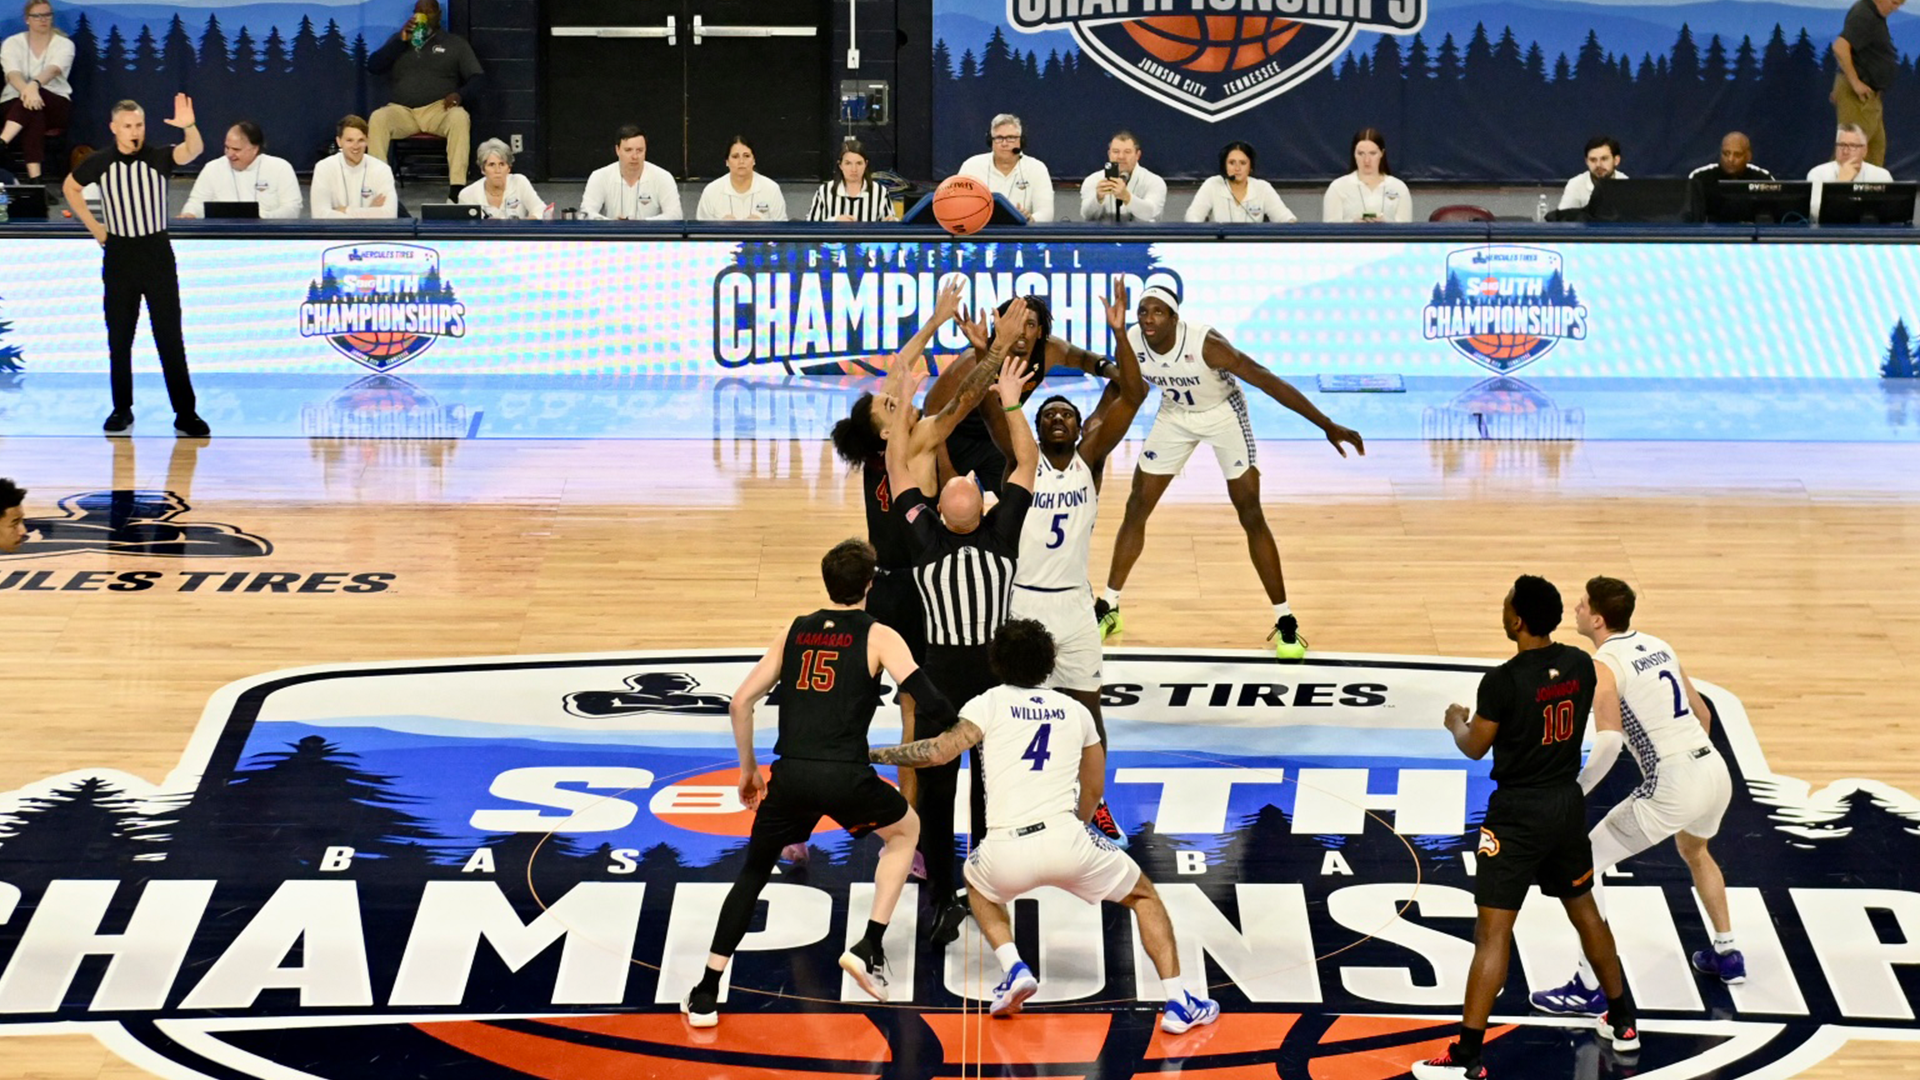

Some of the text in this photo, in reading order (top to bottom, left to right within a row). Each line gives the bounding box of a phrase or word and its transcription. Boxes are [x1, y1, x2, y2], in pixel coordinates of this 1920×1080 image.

[1138, 57, 1281, 97] JOHNSON CITY TENNESSEE
[808, 249, 1081, 269] BASKETBALL
[302, 302, 464, 337] CHAMPIONSHIPS
[1424, 304, 1587, 340] CHAMPIONSHIPS
[1162, 388, 1195, 405] 21
[1169, 376, 1201, 387] POINT
[875, 474, 889, 512] 4
[1058, 486, 1087, 508] POINT
[1045, 513, 1069, 549] 5
[177, 571, 397, 593] TIRES
[795, 632, 853, 647] KAMARAD
[796, 650, 839, 692] 15
[1631, 650, 1672, 676] JOHNSTON
[1159, 683, 1389, 708] TIRES
[1658, 669, 1689, 719] 2
[1010, 706, 1066, 720] WILLIAMS
[1542, 699, 1575, 745] 10
[1021, 723, 1051, 771] 4
